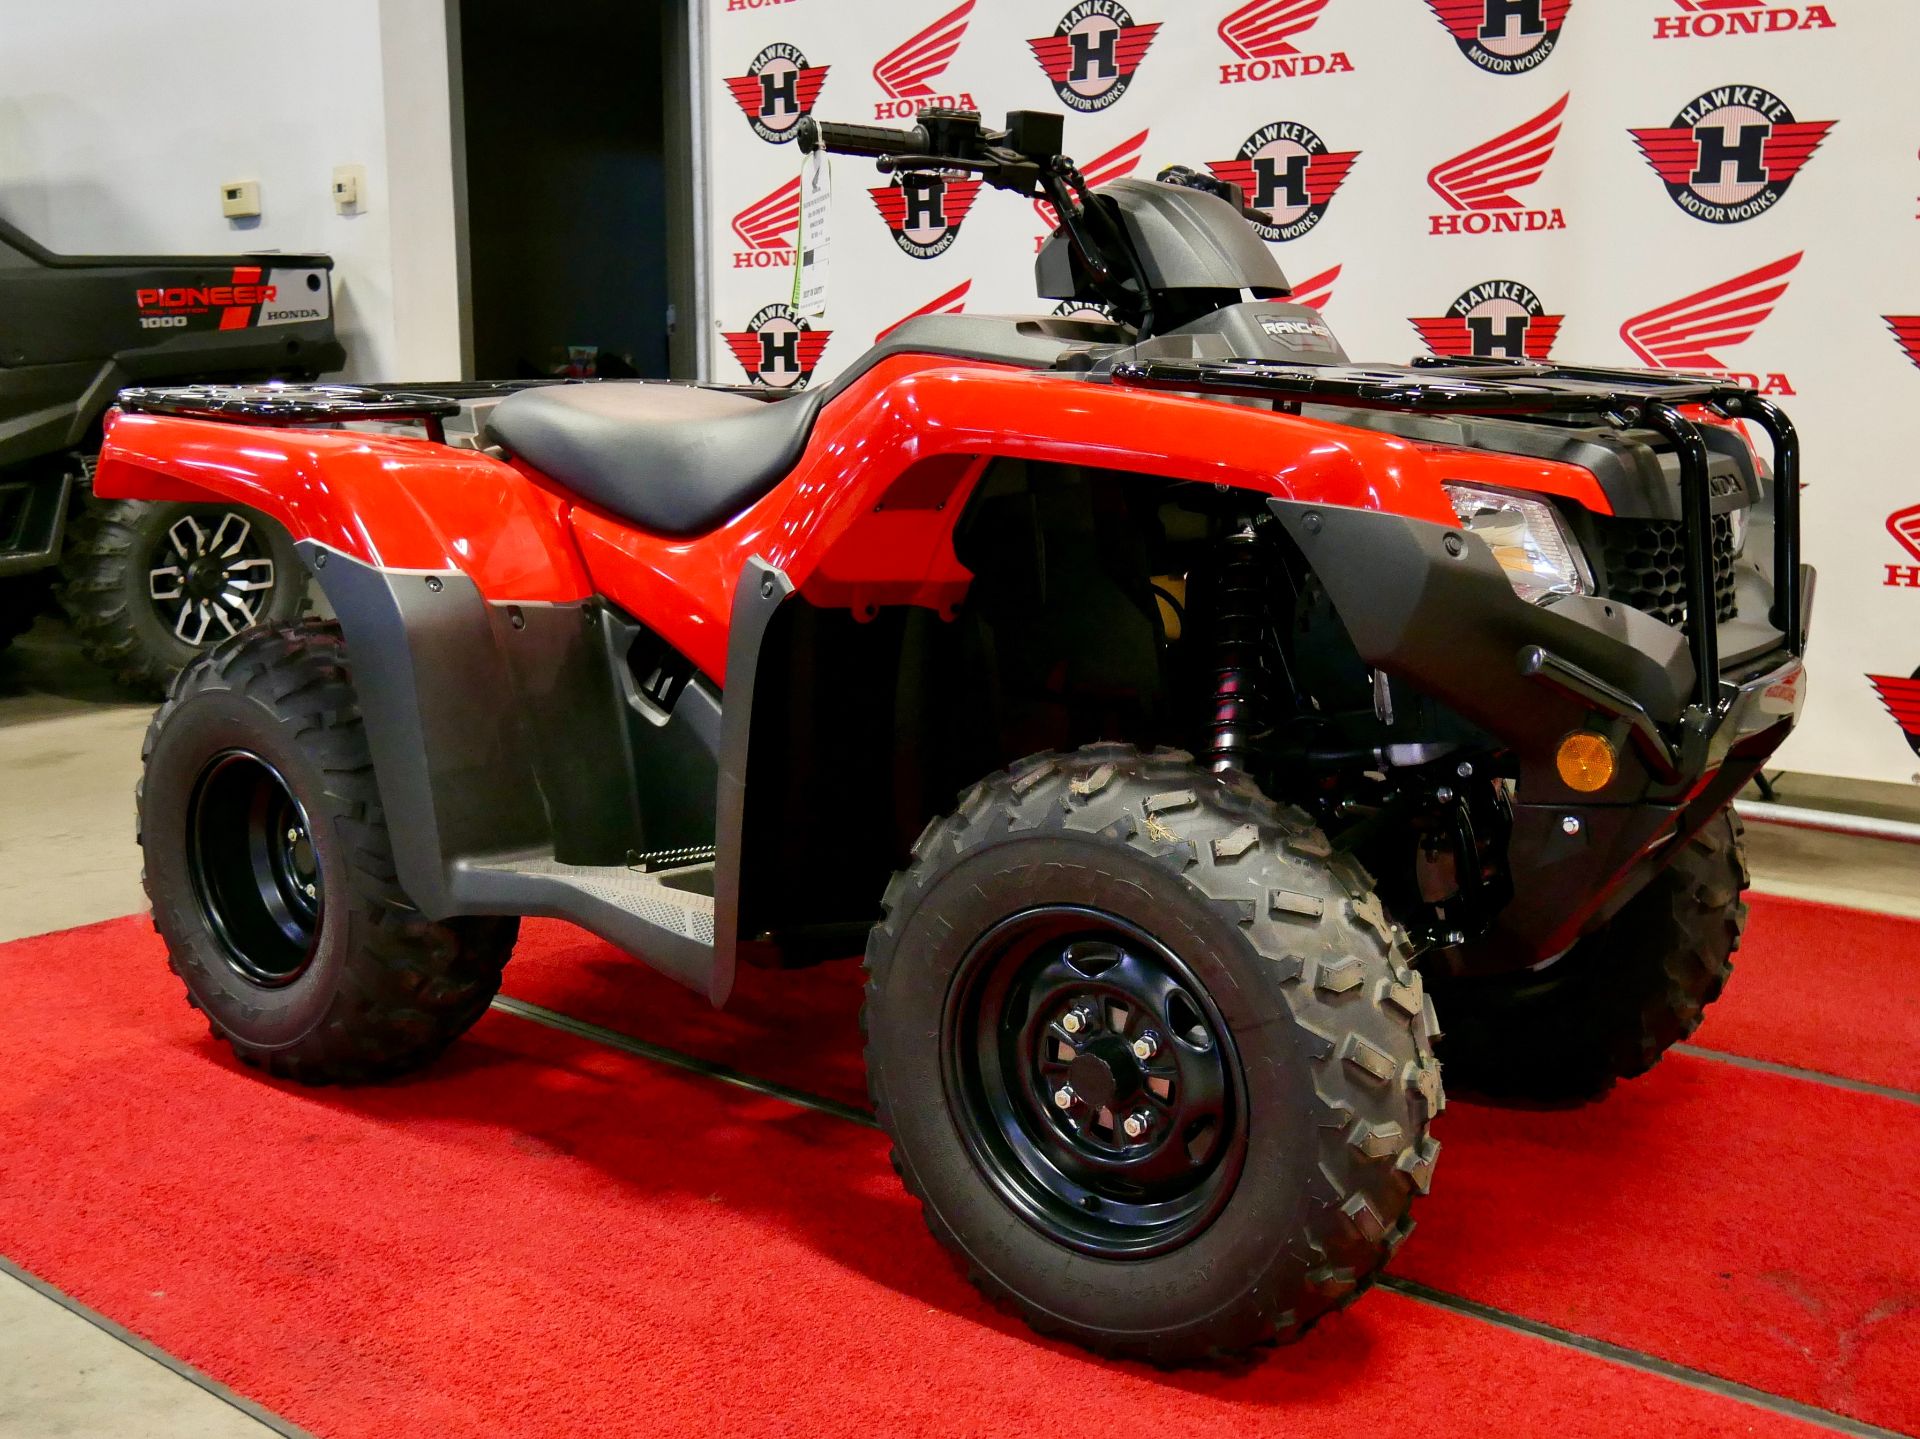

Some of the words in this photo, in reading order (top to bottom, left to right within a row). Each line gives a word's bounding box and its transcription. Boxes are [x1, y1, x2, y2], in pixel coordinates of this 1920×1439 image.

[1060, 1, 1129, 33] HAWKEYE
[1652, 5, 1836, 39] HONDA
[752, 45, 805, 74] HAWKEYE
[1069, 29, 1118, 81] H
[1219, 51, 1355, 84] HONDA
[1468, 46, 1512, 71] MOTOR
[1513, 40, 1553, 71] WORKS
[760, 71, 798, 117] H
[1061, 88, 1092, 110] MOTOR
[1092, 83, 1125, 110] WORKS
[1681, 86, 1787, 125] HAWKEYE
[754, 122, 780, 142] MOTOR
[1242, 123, 1321, 157] HAWKEYE
[1692, 124, 1770, 184] H
[1253, 155, 1310, 208] H
[1678, 191, 1724, 220] MOTOR
[1727, 189, 1777, 220] WORKS
[1252, 221, 1280, 239] OTOR
[1281, 211, 1319, 239] WORKS
[1429, 209, 1566, 235] HONDA
[733, 250, 797, 268] HON
[898, 235, 925, 257] MOTOR
[925, 232, 954, 257] WORKS
[137, 285, 277, 308] PIONEER
[1453, 282, 1539, 316] HAWKEYE
[140, 316, 187, 328] 1000
[267, 309, 320, 321] HONDA
[760, 332, 799, 372] H
